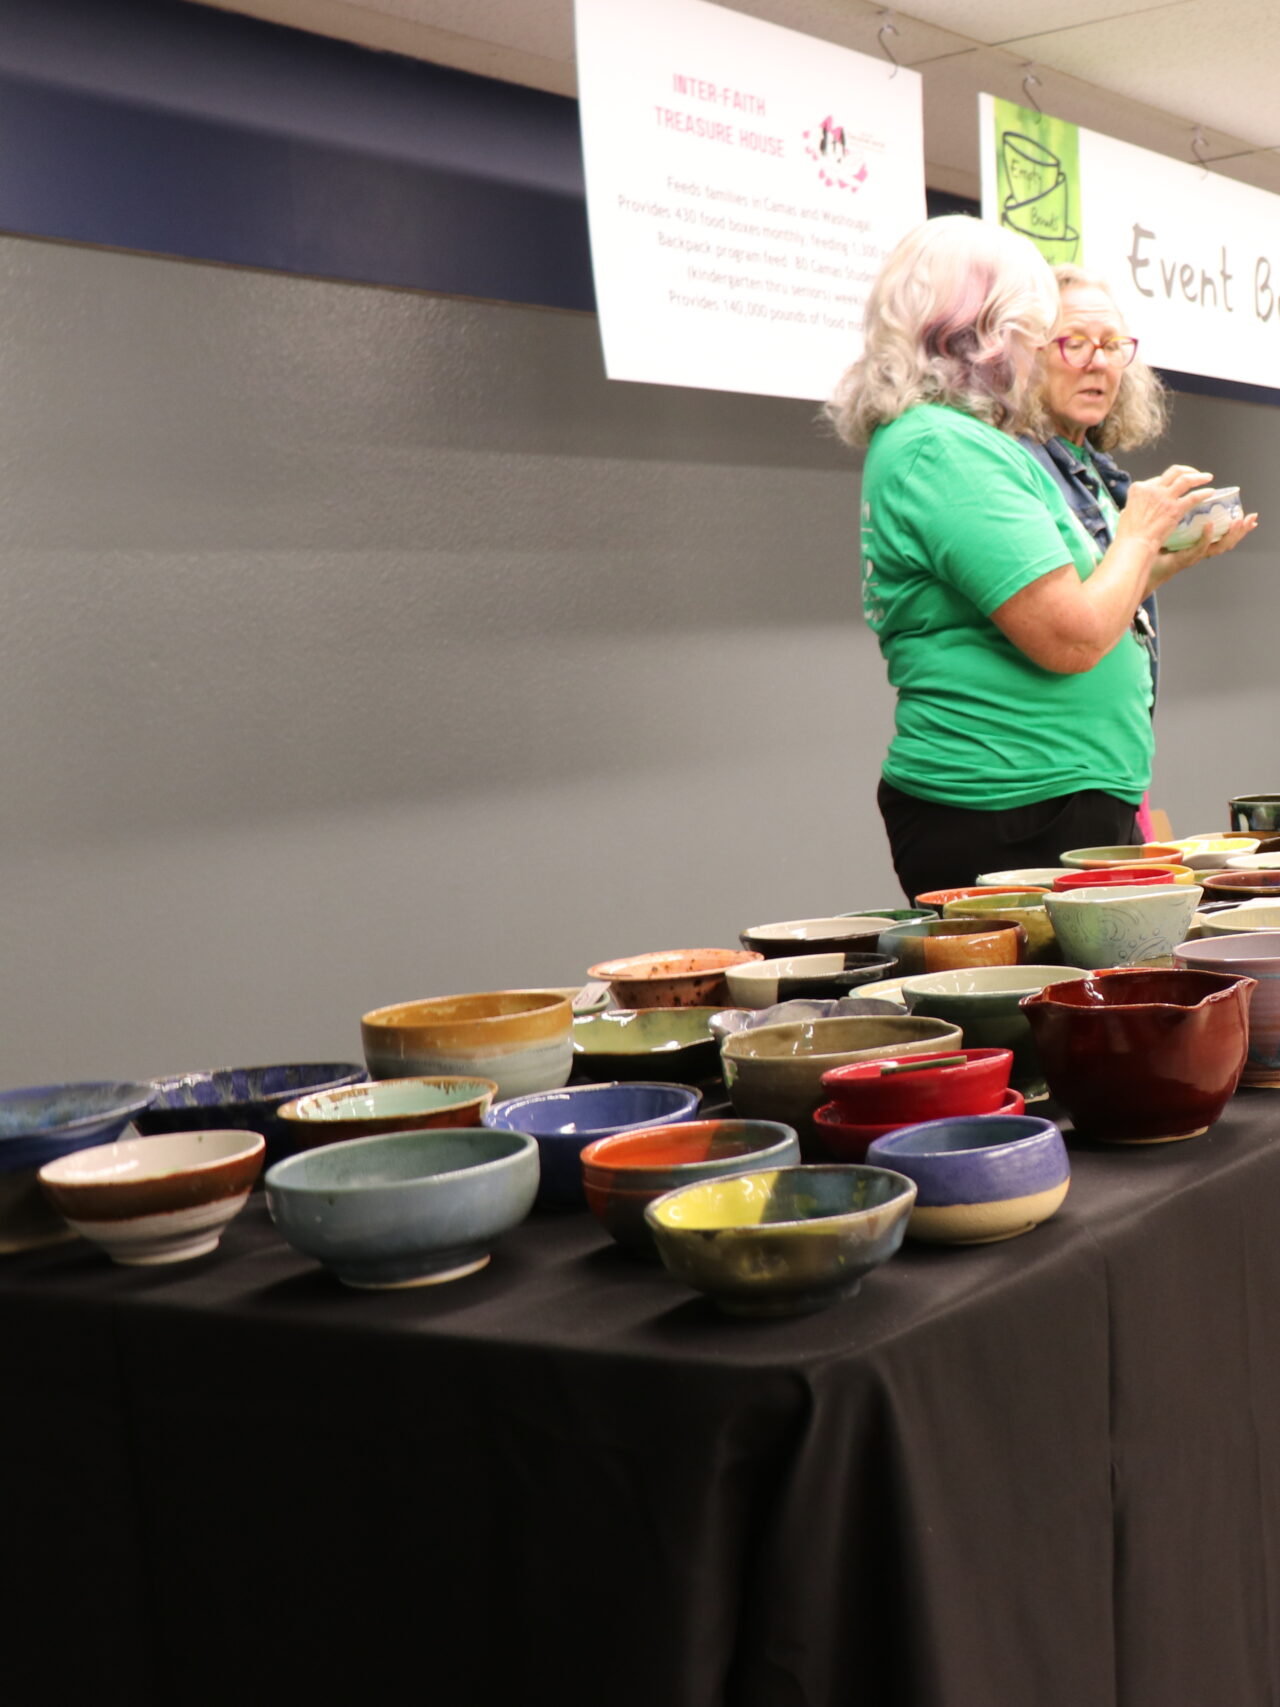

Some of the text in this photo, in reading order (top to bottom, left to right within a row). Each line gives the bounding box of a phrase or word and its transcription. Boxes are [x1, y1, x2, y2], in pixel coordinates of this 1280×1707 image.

[673, 73, 766, 117] INTER-FAITH
[654, 105, 785, 159] TREASURE HOUSE
[667, 175, 702, 197] Feeds
[763, 197, 797, 216] Camas
[800, 207, 819, 222] and
[617, 194, 671, 220] Provides
[700, 211, 726, 230] food
[728, 216, 761, 238] boxes
[810, 233, 849, 257] feeding
[657, 230, 711, 256] Backpack
[716, 244, 761, 265] program
[811, 258, 842, 277] Camas
[1126, 222, 1234, 313] Event
[668, 288, 720, 313] Provides
[769, 306, 807, 325] pounds
[809, 311, 820, 325] of
[823, 312, 845, 331] food
